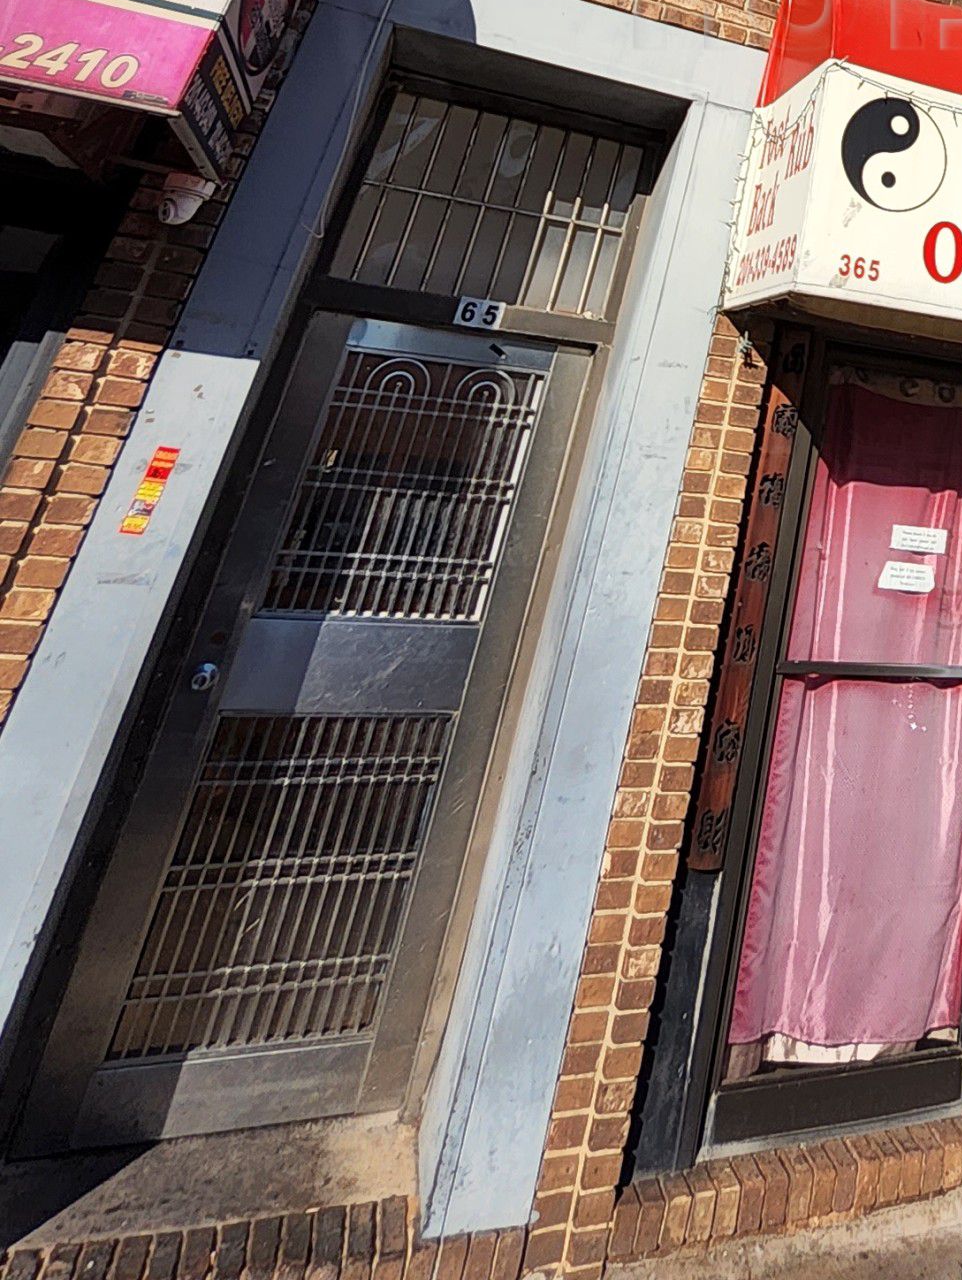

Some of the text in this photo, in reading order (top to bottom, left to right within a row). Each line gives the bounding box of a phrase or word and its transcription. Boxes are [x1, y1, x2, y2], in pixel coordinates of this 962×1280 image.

[746, 171, 780, 236] Back
[838, 254, 880, 282] 365
[461, 302, 499, 325] 65
